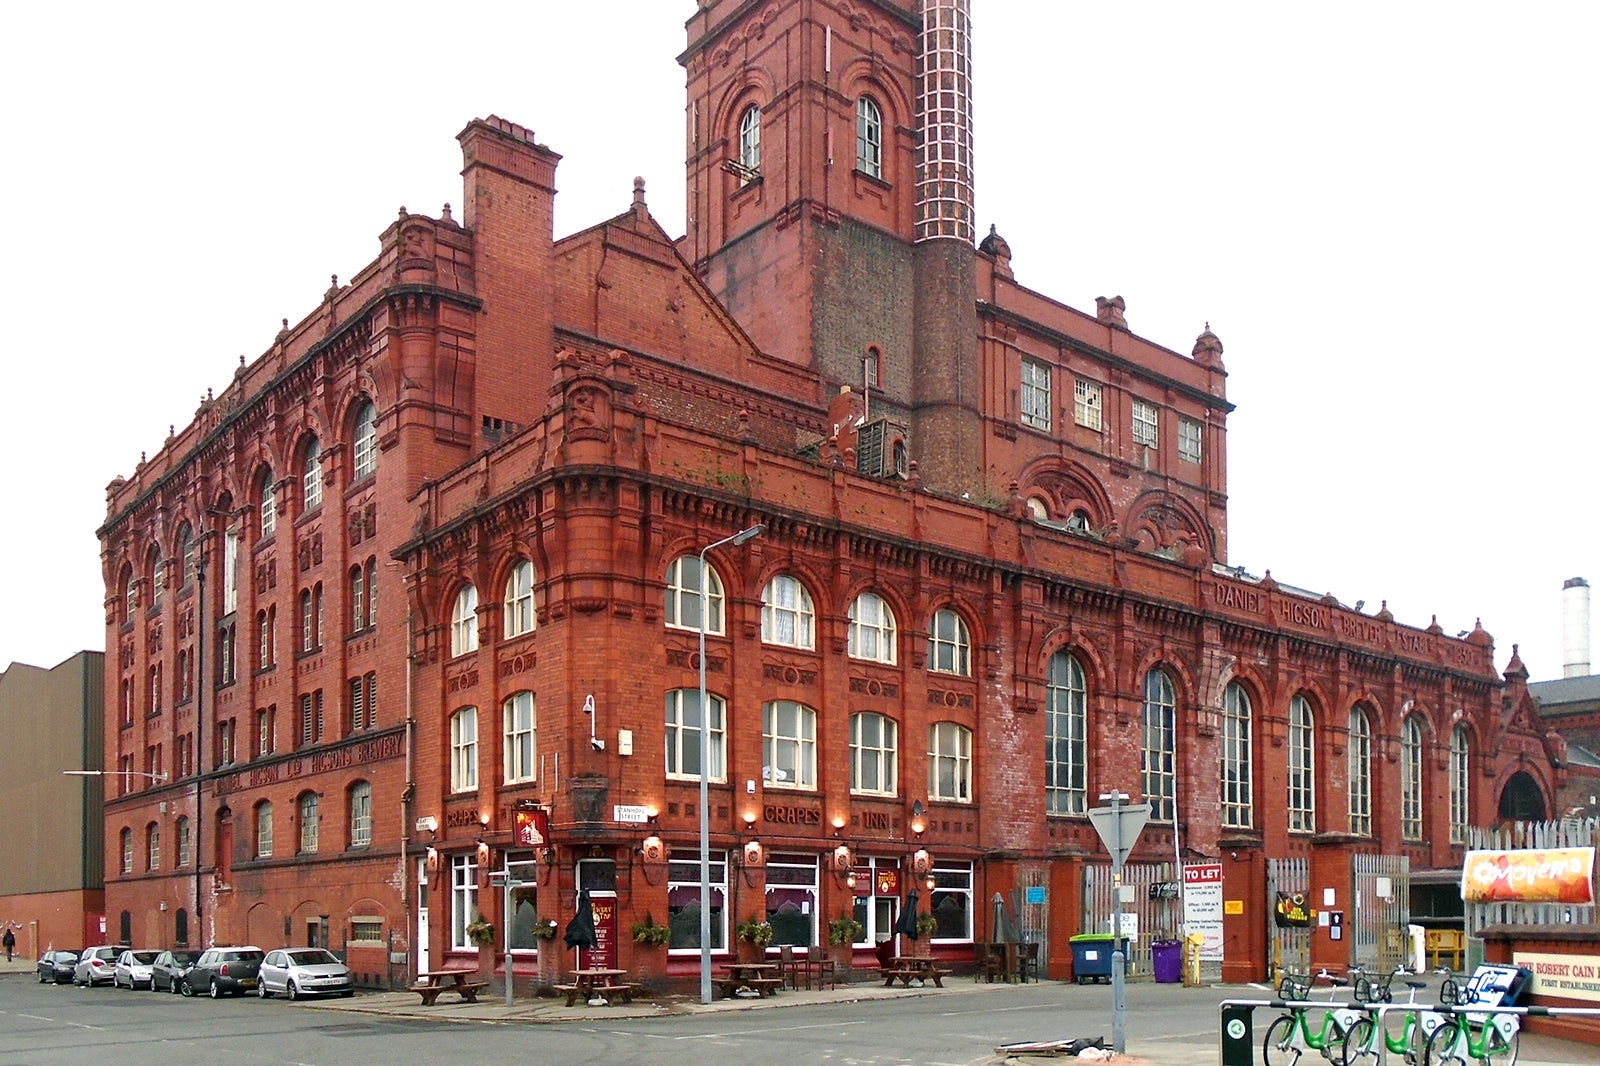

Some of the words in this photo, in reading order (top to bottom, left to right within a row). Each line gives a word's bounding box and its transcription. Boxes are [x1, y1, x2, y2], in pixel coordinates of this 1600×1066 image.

[1215, 583, 1265, 615] DANIEL
[1280, 600, 1329, 628] HIGSON
[250, 765, 279, 787] HIGSON
[311, 747, 352, 773] HIGSONS
[357, 734, 403, 762] BREWERY
[446, 808, 480, 828] GRAPES
[764, 806, 822, 826] GRAPES
[864, 813, 892, 830] INN
[1185, 870, 1199, 880] TO
[1201, 869, 1220, 879] LET
[1518, 962, 1534, 973] THE
[1536, 963, 1570, 976] ROBERT
[1572, 965, 1594, 978] CAIN
[1541, 979, 1558, 988] FIRST
